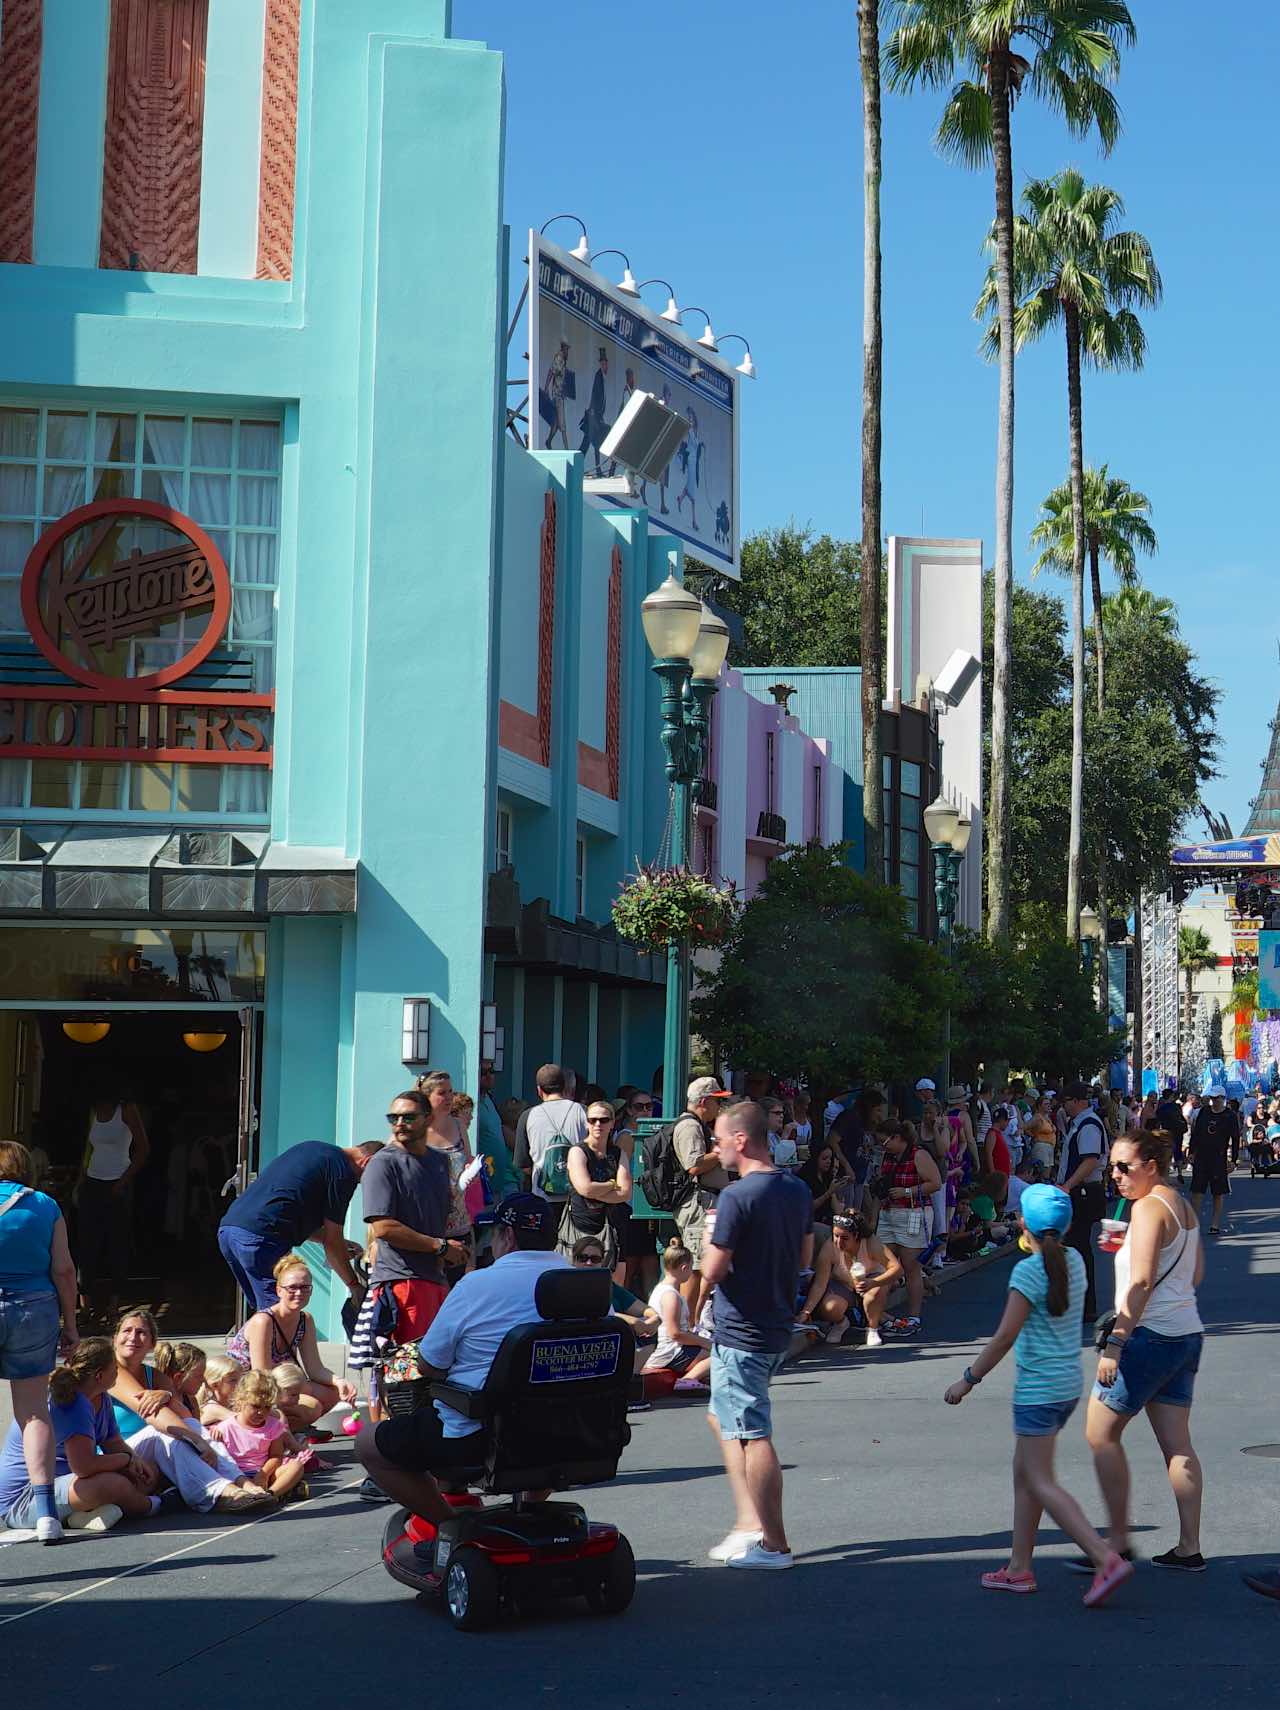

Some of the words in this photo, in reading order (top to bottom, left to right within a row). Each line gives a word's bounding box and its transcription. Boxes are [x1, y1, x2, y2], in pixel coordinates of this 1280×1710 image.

[572, 284, 596, 318] STAR
[598, 301, 618, 330] LINE
[49, 515, 213, 679] Keystone
[535, 1356, 577, 1366] SCOOTER
[577, 1352, 615, 1362] RENTALS
[536, 1344, 578, 1358] BUENA
[581, 1340, 616, 1354] VISTA
